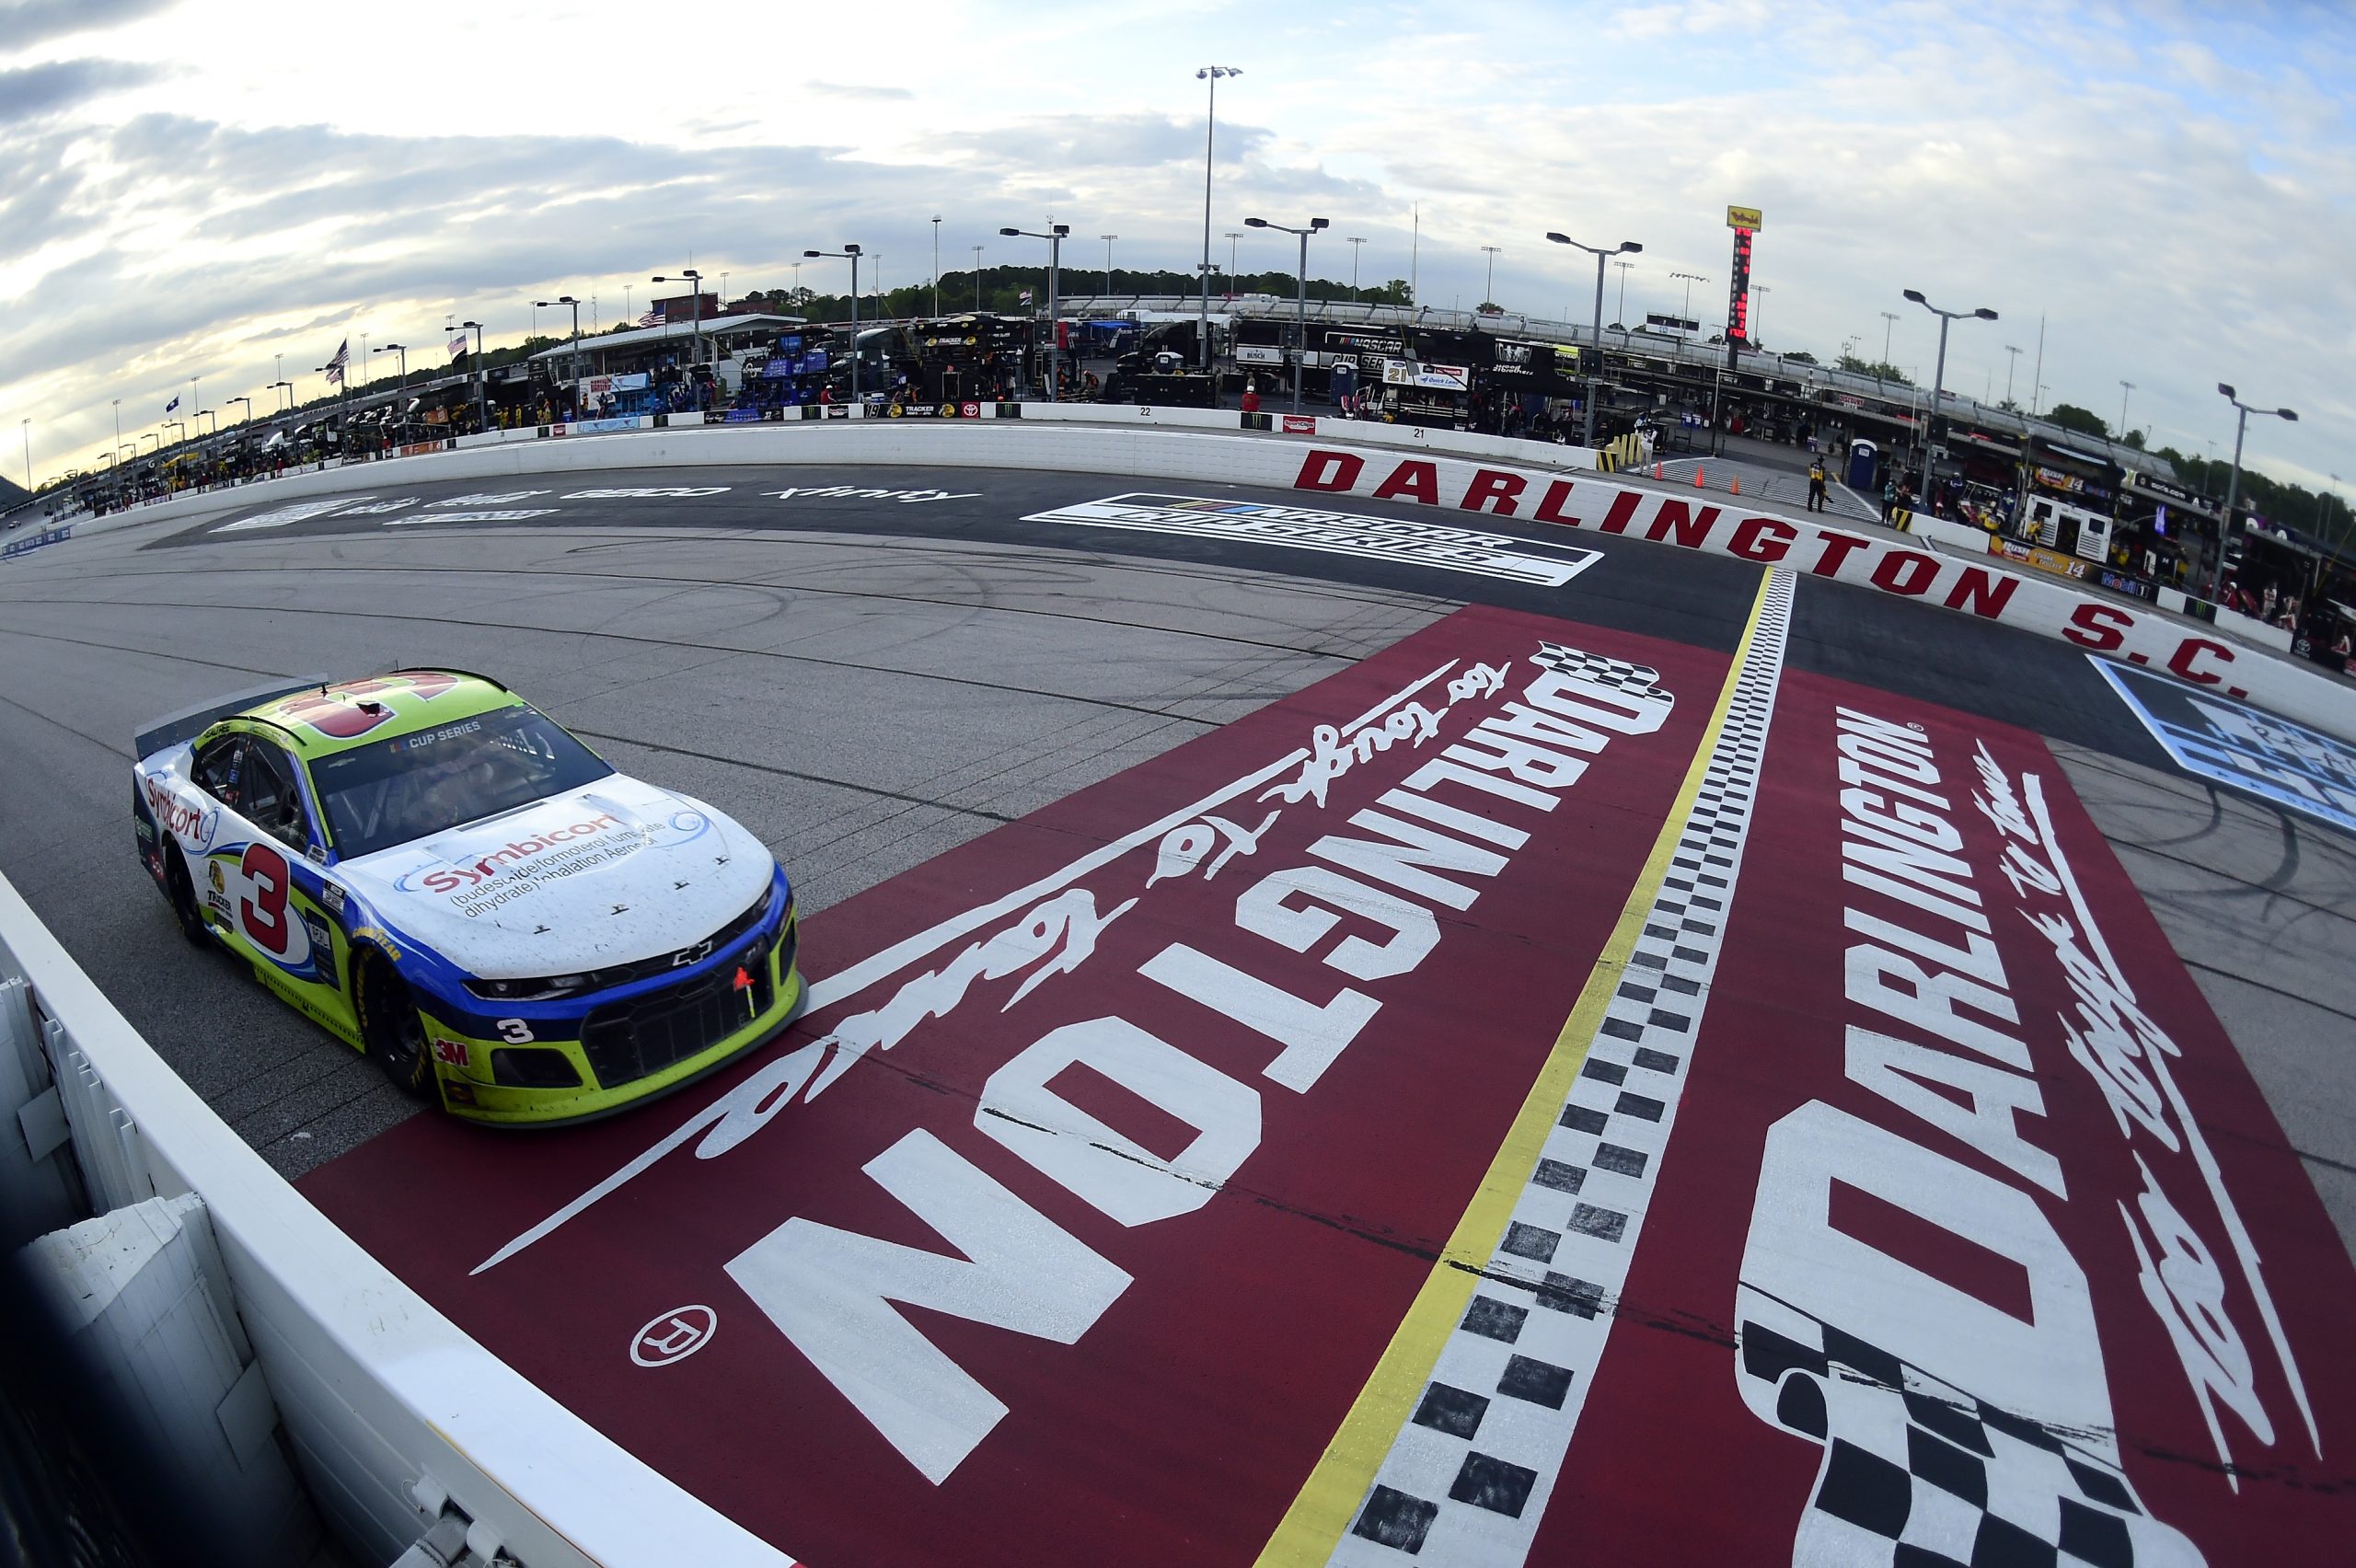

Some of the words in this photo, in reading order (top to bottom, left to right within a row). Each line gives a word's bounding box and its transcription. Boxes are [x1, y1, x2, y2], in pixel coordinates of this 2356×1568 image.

[1355, 338, 1403, 353] NASCAR
[1362, 355, 1386, 369] SER
[1388, 368, 1406, 382] 21
[1140, 407, 1150, 417] 22
[1415, 429, 1425, 438] 21
[560, 487, 733, 500] GEICO
[2067, 477, 2084, 491] 14
[1110, 510, 1254, 526] CUP
[1244, 525, 1496, 563] SERIES
[1240, 507, 1514, 548] NASCAR
[2003, 541, 2030, 558] RUSH
[1294, 450, 2020, 619] DARLINGTON
[2062, 604, 2247, 698] S.C.
[2064, 560, 2086, 579] 14
[2101, 571, 2136, 595] Mobil
[410, 733, 435, 748] CUP
[437, 721, 481, 741] SERIES
[148, 778, 201, 839] Symbicort
[607, 822, 666, 845] fumate
[606, 836, 658, 860] Aerool
[241, 842, 289, 955] 3
[497, 1018, 534, 1044] 3
[435, 1039, 469, 1066] 3M
[723, 669, 1674, 1486] DARLINGTON
[1738, 706, 2121, 1469] DARLINGTON
